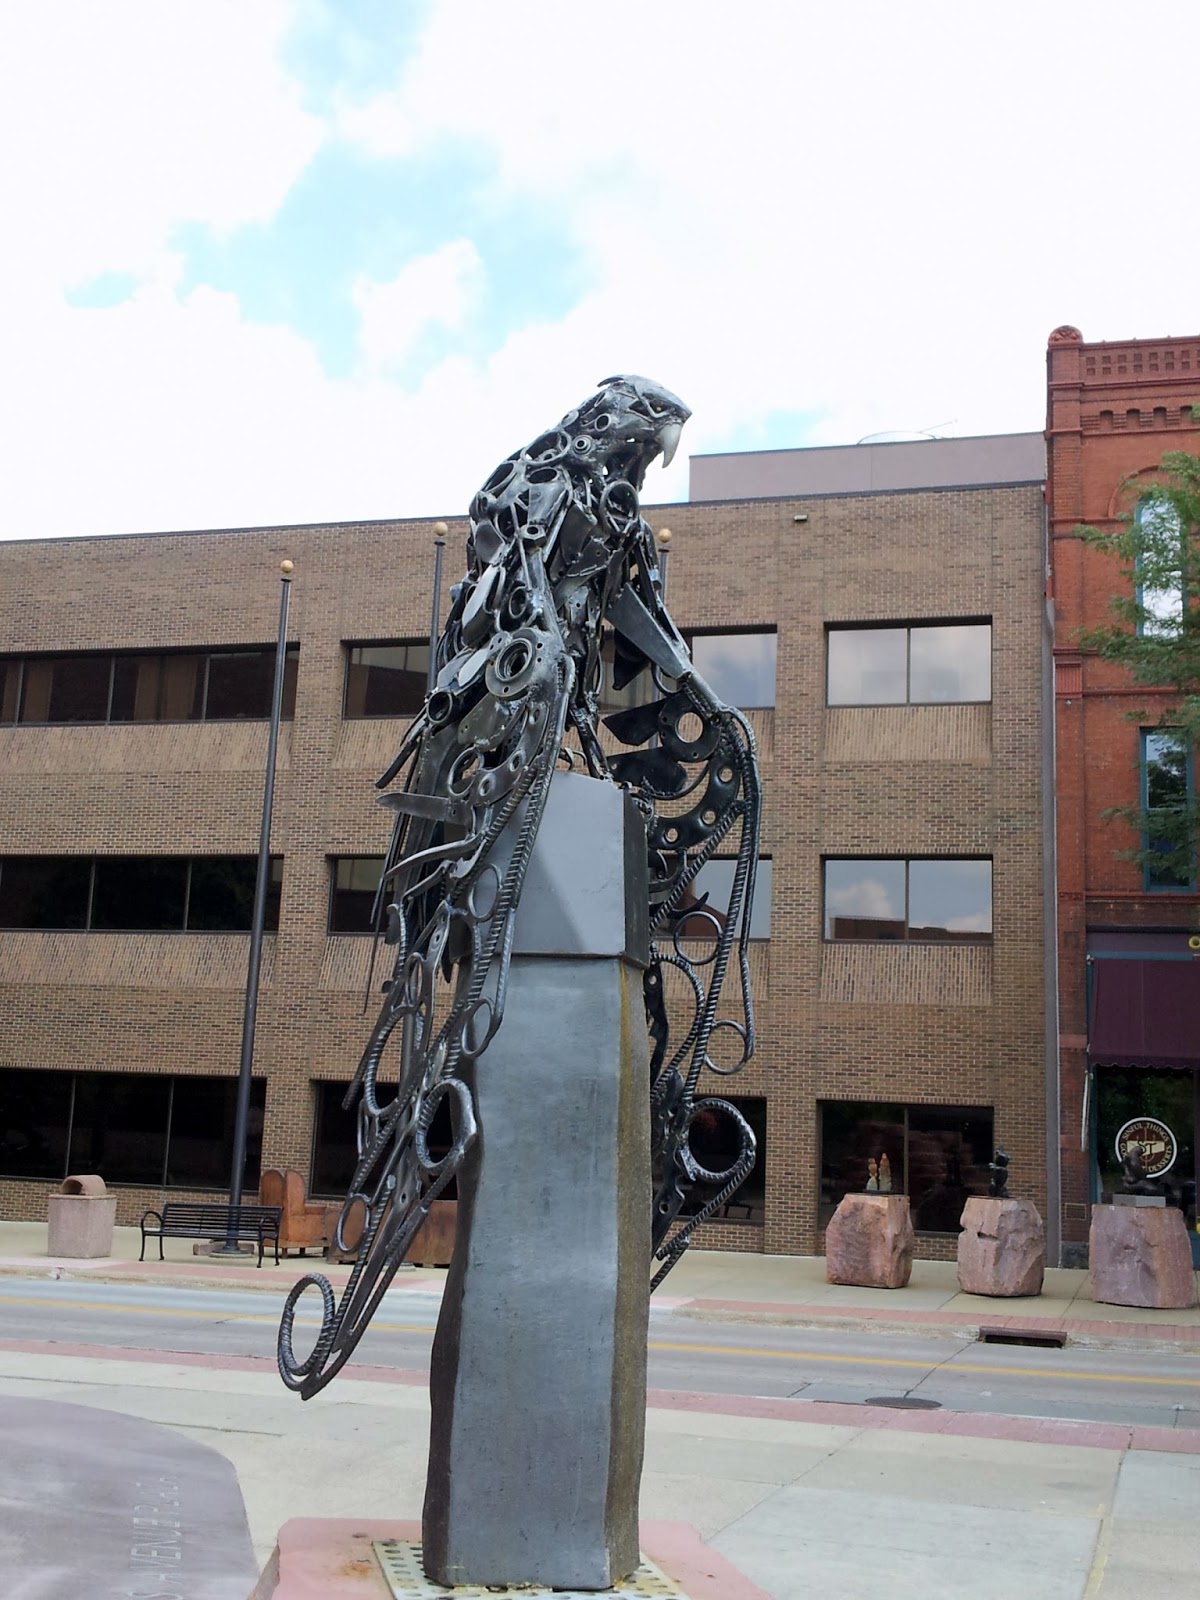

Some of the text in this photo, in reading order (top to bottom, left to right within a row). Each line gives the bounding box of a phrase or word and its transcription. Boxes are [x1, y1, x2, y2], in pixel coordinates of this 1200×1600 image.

[1122, 1122, 1170, 1142] SINFUL THINGS
[1148, 1145, 1172, 1172] DESSERTS
